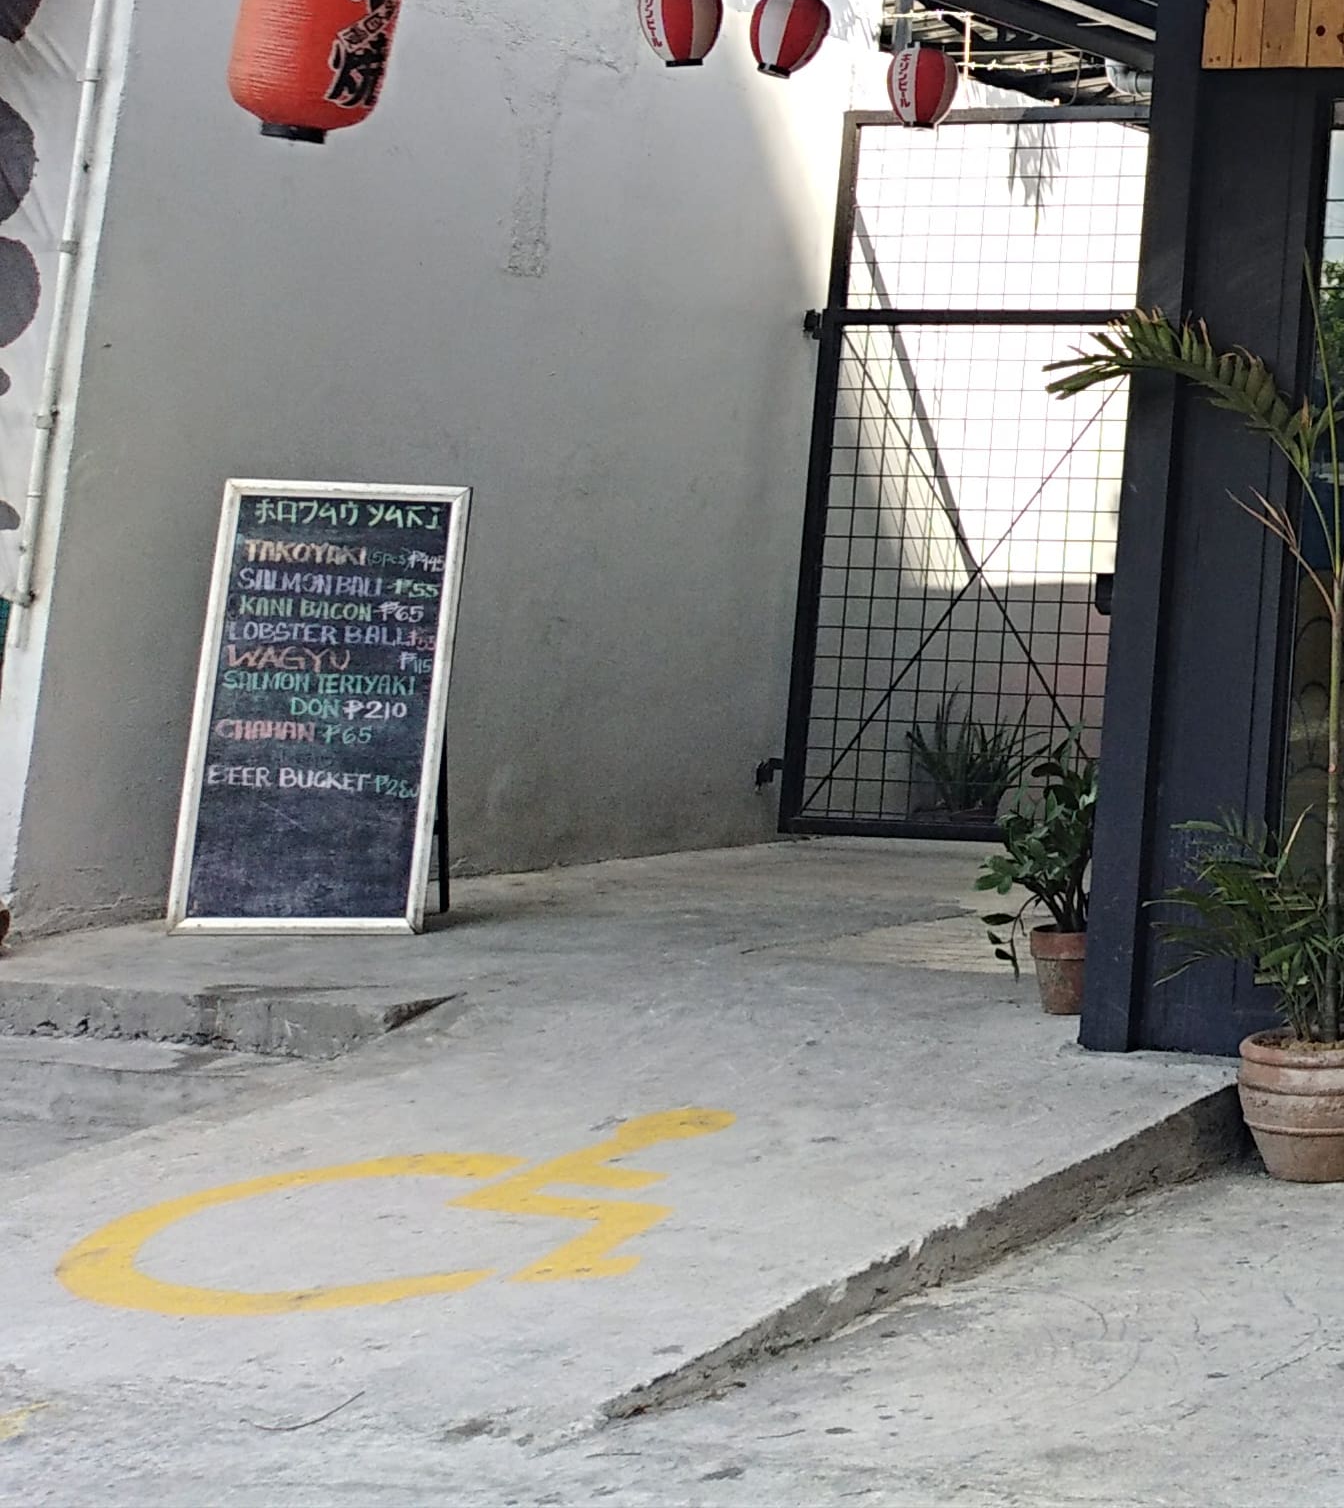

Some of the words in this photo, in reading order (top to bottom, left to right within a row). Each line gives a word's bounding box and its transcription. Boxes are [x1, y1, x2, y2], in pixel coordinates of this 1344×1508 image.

[244, 539, 367, 567] TAKOYAKI
[237, 567, 332, 597] SALMON
[239, 595, 293, 618] KANI
[300, 597, 373, 623] BACON
[227, 621, 338, 646] LOBSTER
[344, 624, 408, 647] BALL
[226, 643, 352, 674] WAGYU
[221, 669, 311, 693] SALMON
[313, 672, 417, 697] TERIYAKI
[289, 696, 341, 720] DON
[214, 718, 316, 742] CHAHAN
[206, 763, 273, 788] BEER
[278, 766, 371, 792] BUCKET
